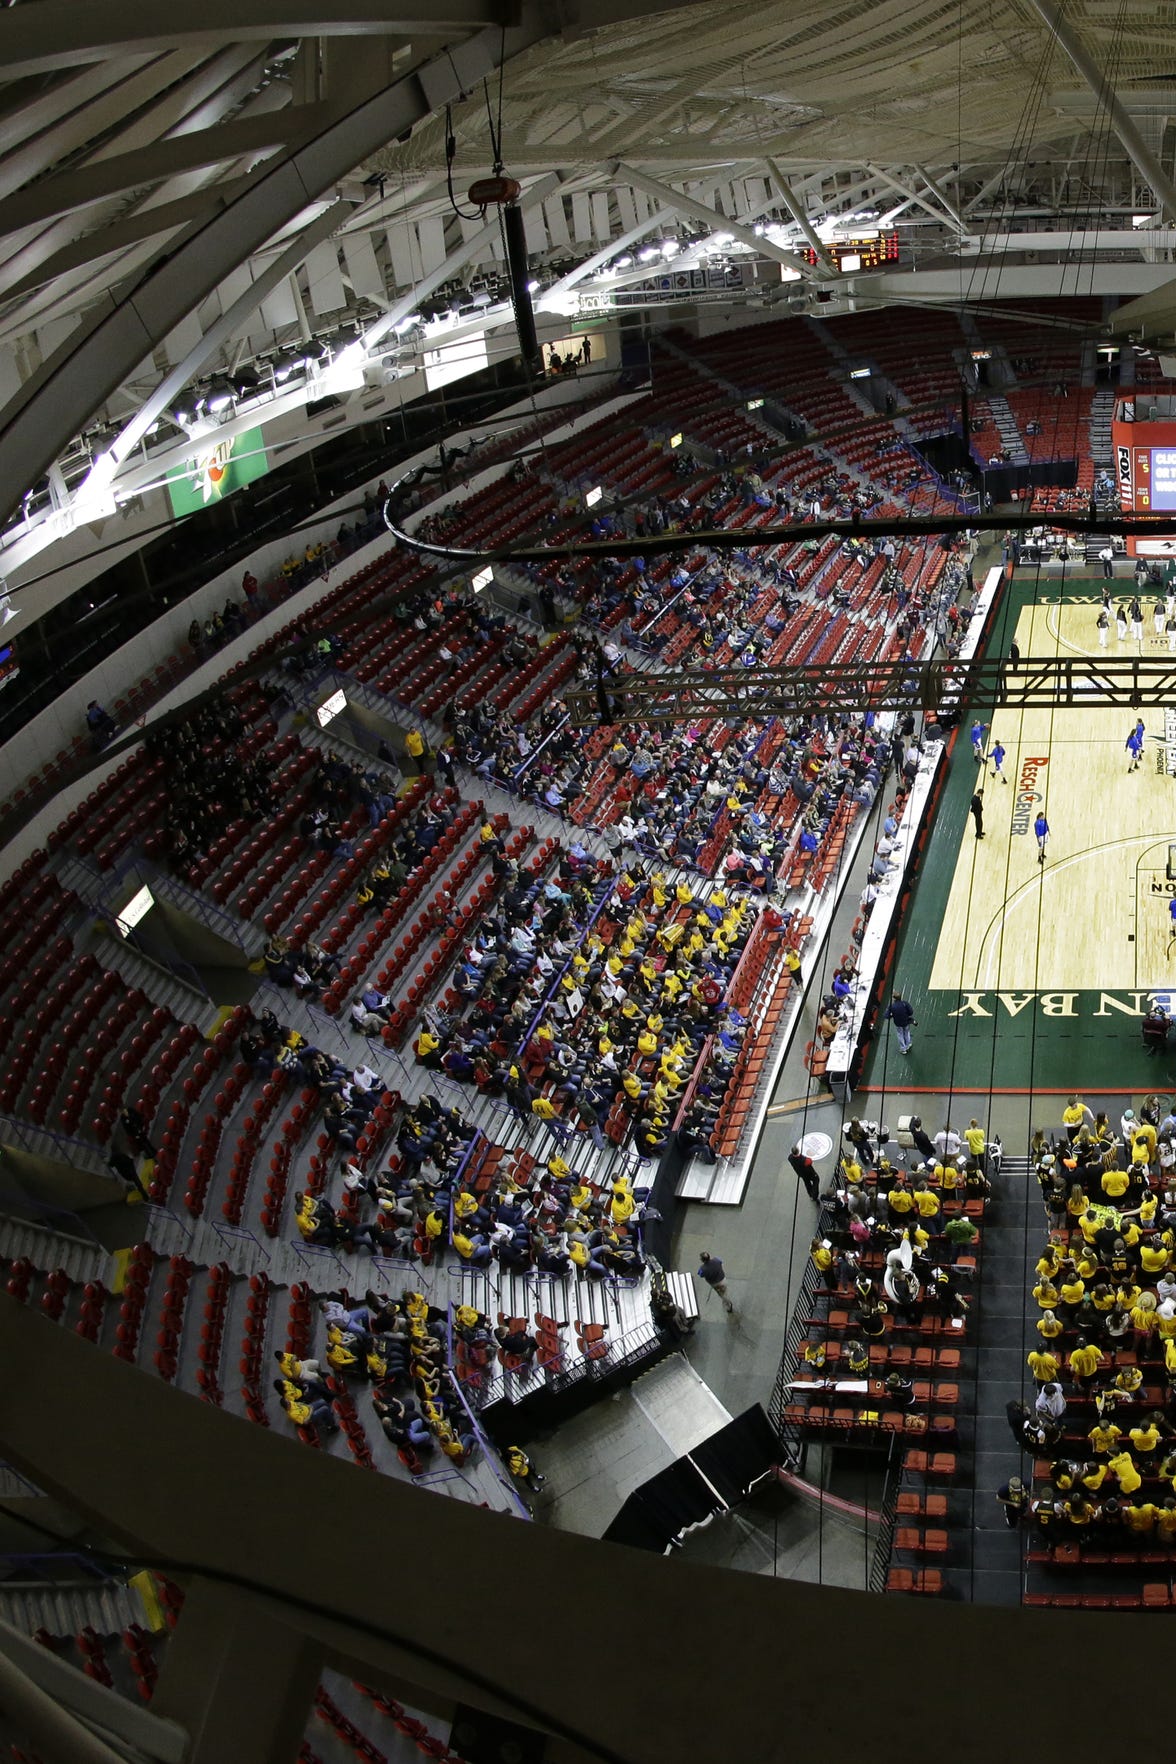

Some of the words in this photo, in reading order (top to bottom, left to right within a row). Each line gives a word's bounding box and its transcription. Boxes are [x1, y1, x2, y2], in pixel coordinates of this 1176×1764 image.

[1119, 447, 1131, 482] FOX
[1019, 757, 1050, 791] RESCH
[1011, 791, 1043, 836] CENTER
[947, 992, 1080, 1017] BAY
